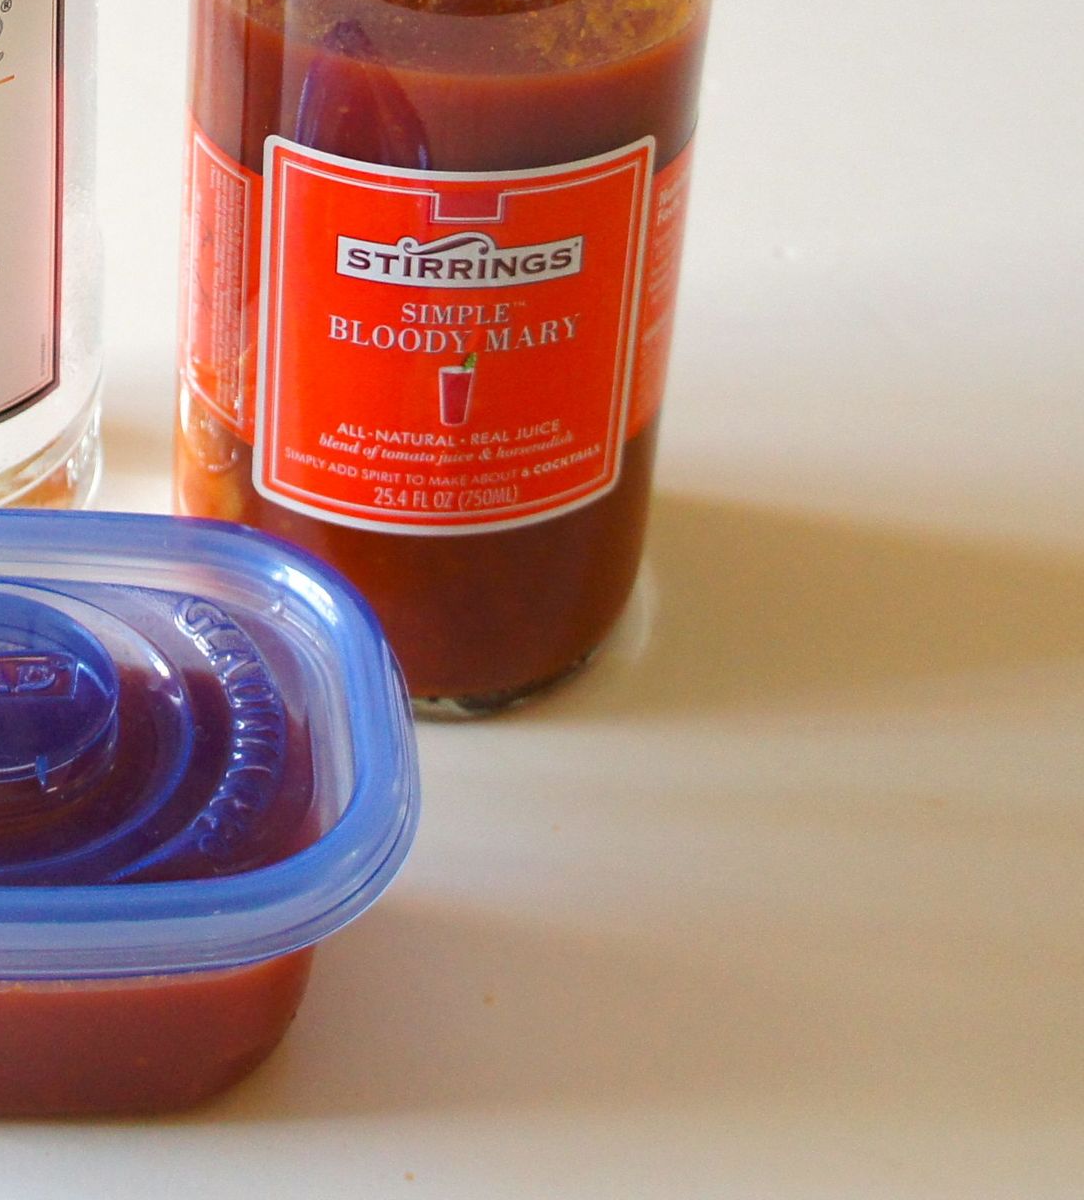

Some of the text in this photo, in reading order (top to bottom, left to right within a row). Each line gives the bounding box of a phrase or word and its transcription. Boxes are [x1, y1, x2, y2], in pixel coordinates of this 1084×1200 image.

[346, 246, 573, 280] STIRRINGS
[328, 313, 580, 354] BLOODY MARY
[318, 430, 575, 466] blend of tomato juice & horseradish
[470, 431, 510, 445] REAL
[515, 419, 561, 440] JUICE
[284, 447, 325, 469] SIMPLY
[328, 462, 357, 477] ADD
[361, 468, 401, 484] SPIRIT
[404, 473, 424, 486] TO
[428, 475, 466, 487] MAKE
[471, 470, 517, 485] ABOUT
[533, 443, 601, 474] COCKTAILS
[373, 486, 408, 507] 25.4
[412, 490, 429, 508] FL
[433, 491, 454, 509] OZ
